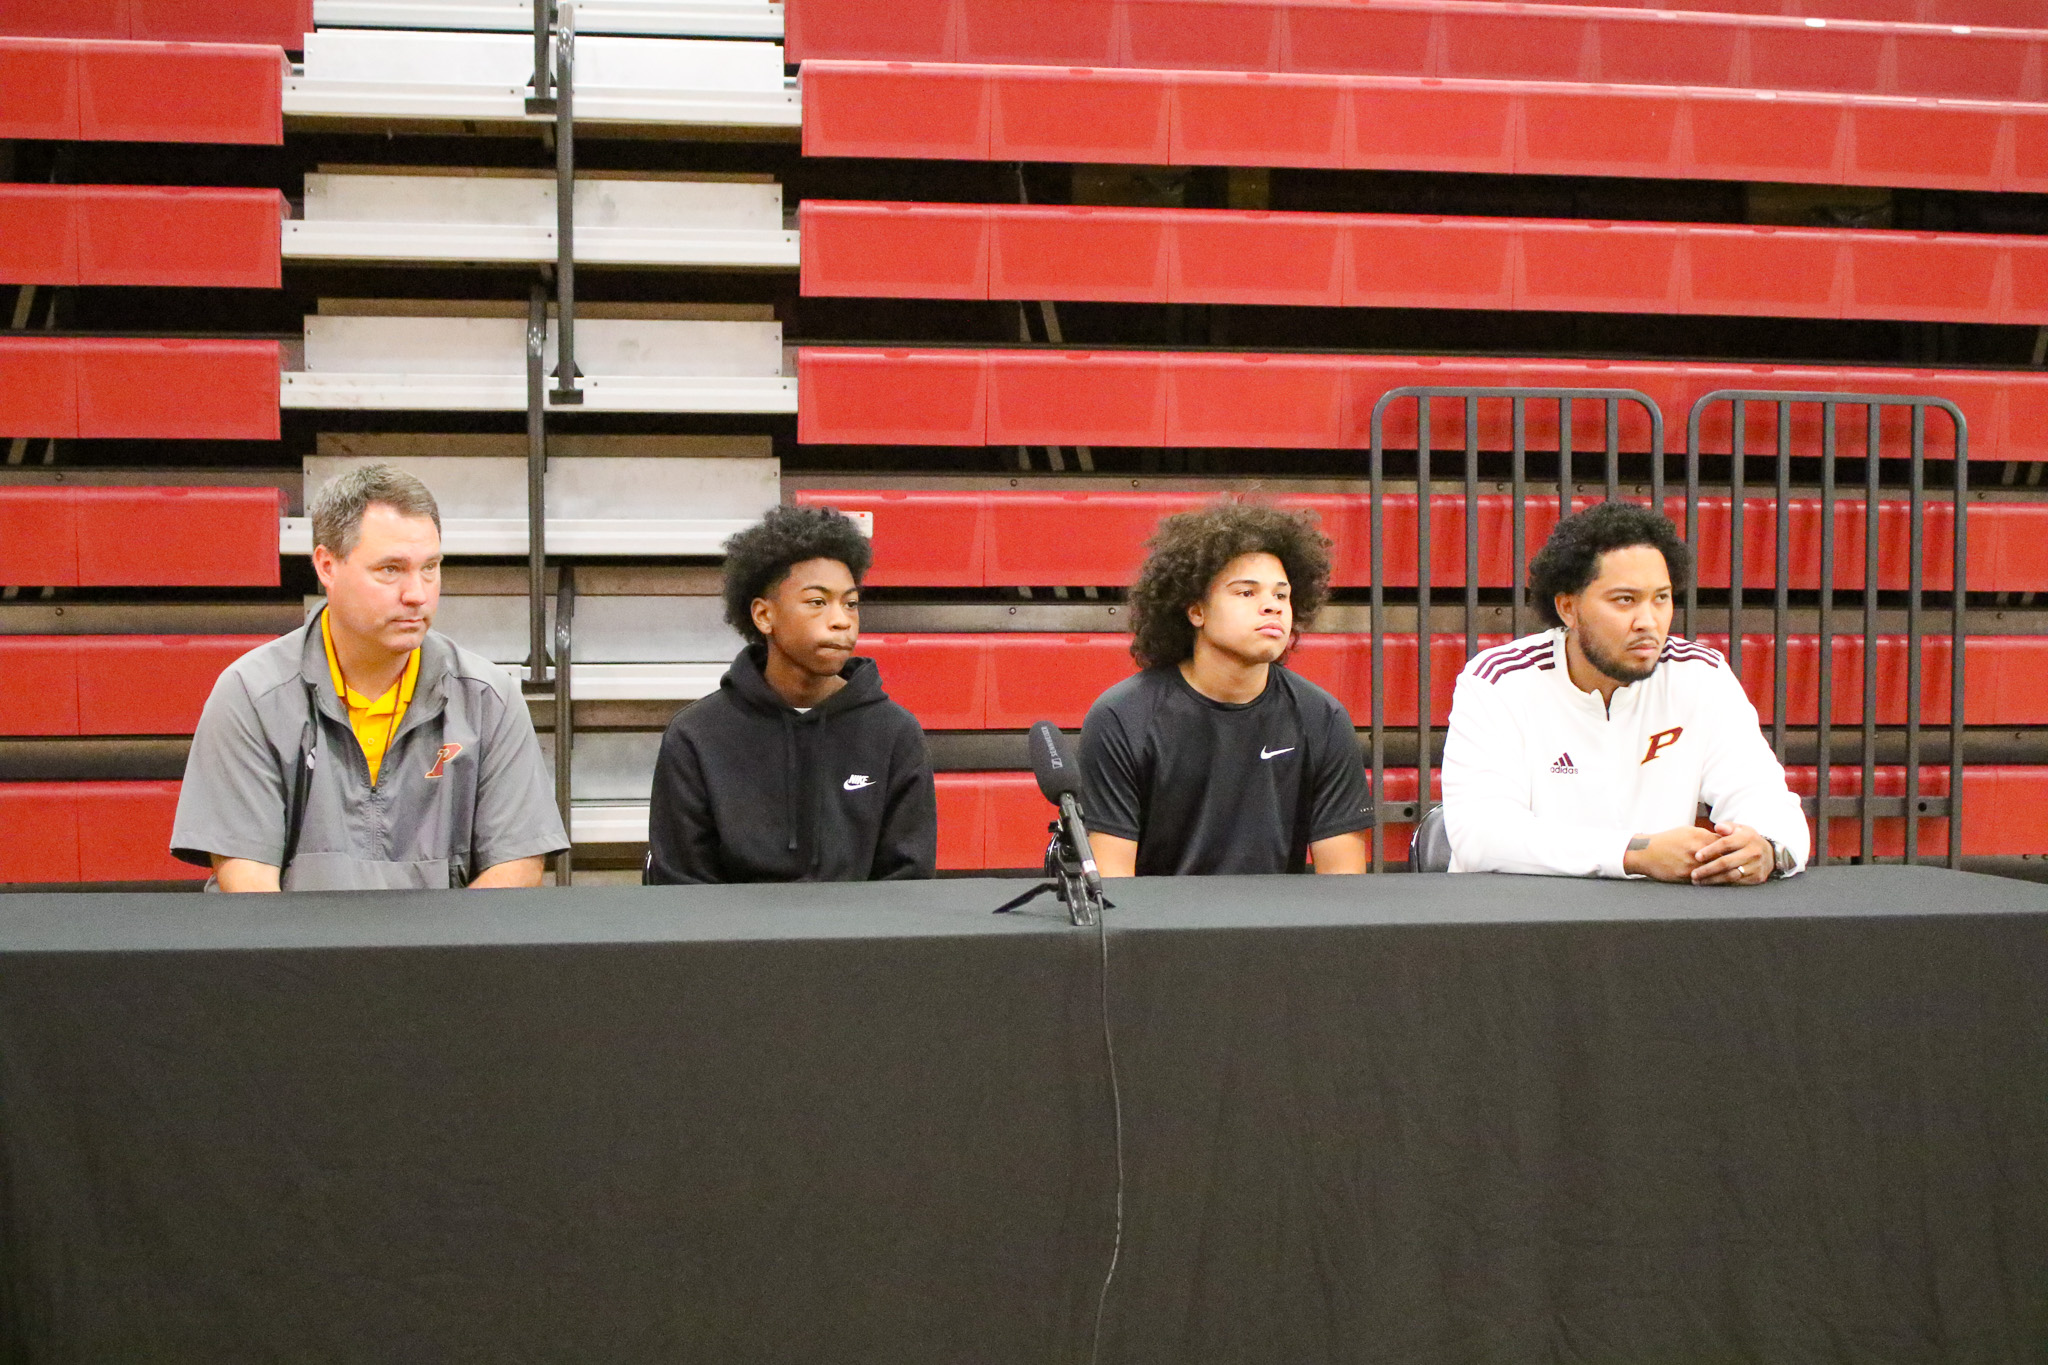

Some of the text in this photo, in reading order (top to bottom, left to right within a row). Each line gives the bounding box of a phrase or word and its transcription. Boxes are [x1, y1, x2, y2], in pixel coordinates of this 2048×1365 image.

[1640, 726, 1683, 766] P
[424, 743, 462, 778] P
[1550, 766, 1578, 774] adidas
[848, 774, 869, 784] NIKE
